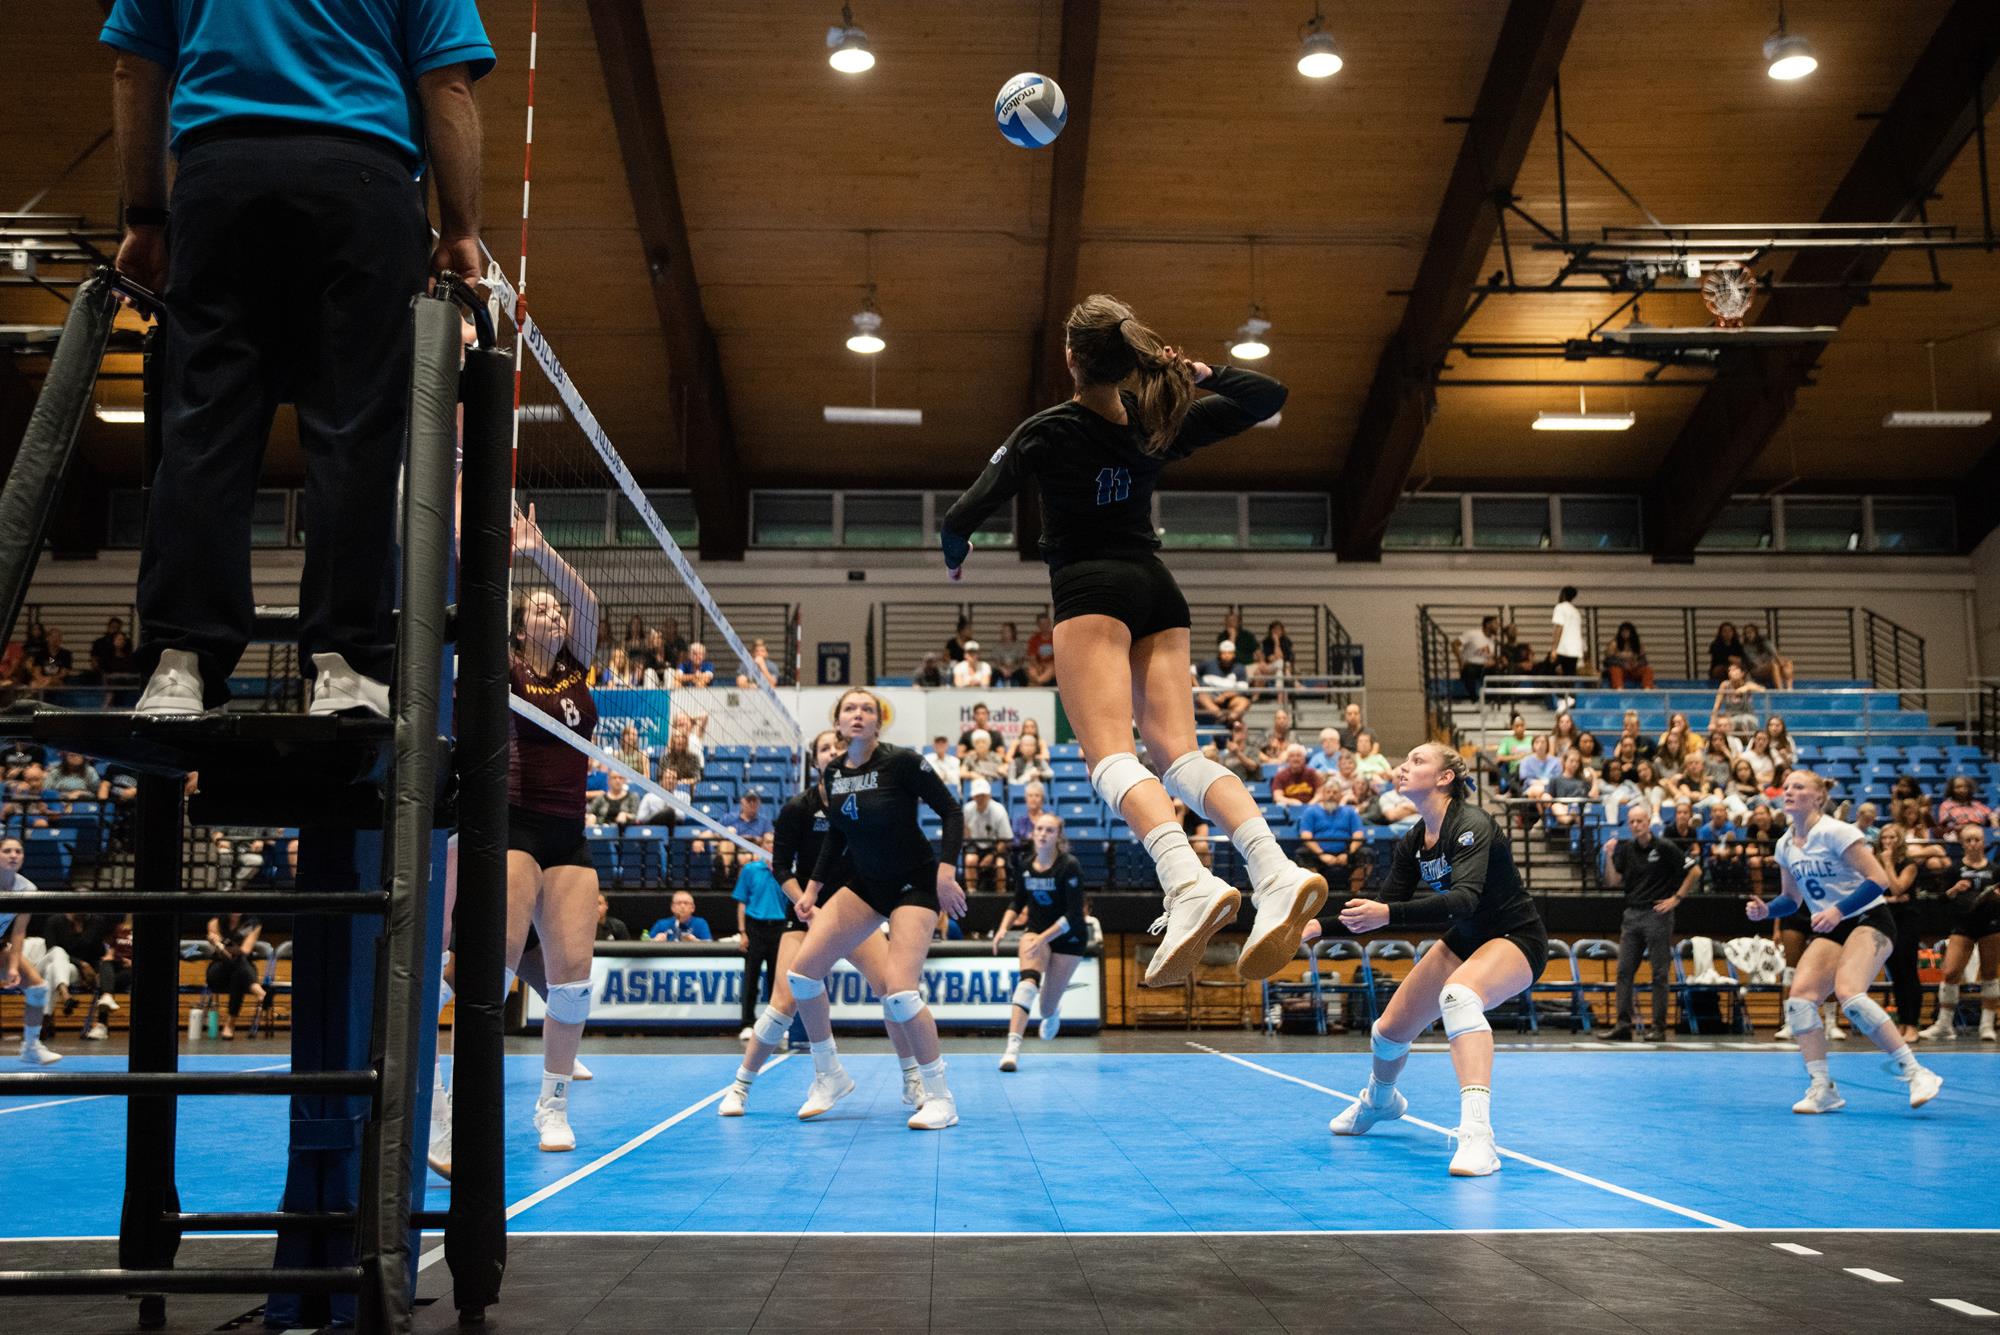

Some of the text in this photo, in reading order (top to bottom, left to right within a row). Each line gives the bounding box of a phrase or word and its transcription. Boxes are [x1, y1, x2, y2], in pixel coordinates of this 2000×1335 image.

[1002, 87, 1036, 116] molten
[1096, 467, 1131, 505] 11
[560, 697, 581, 727] 8
[841, 793, 858, 820] 4
[1805, 878, 1826, 900] 6
[600, 970, 1021, 1004] ASHEVI VOLYBAL
